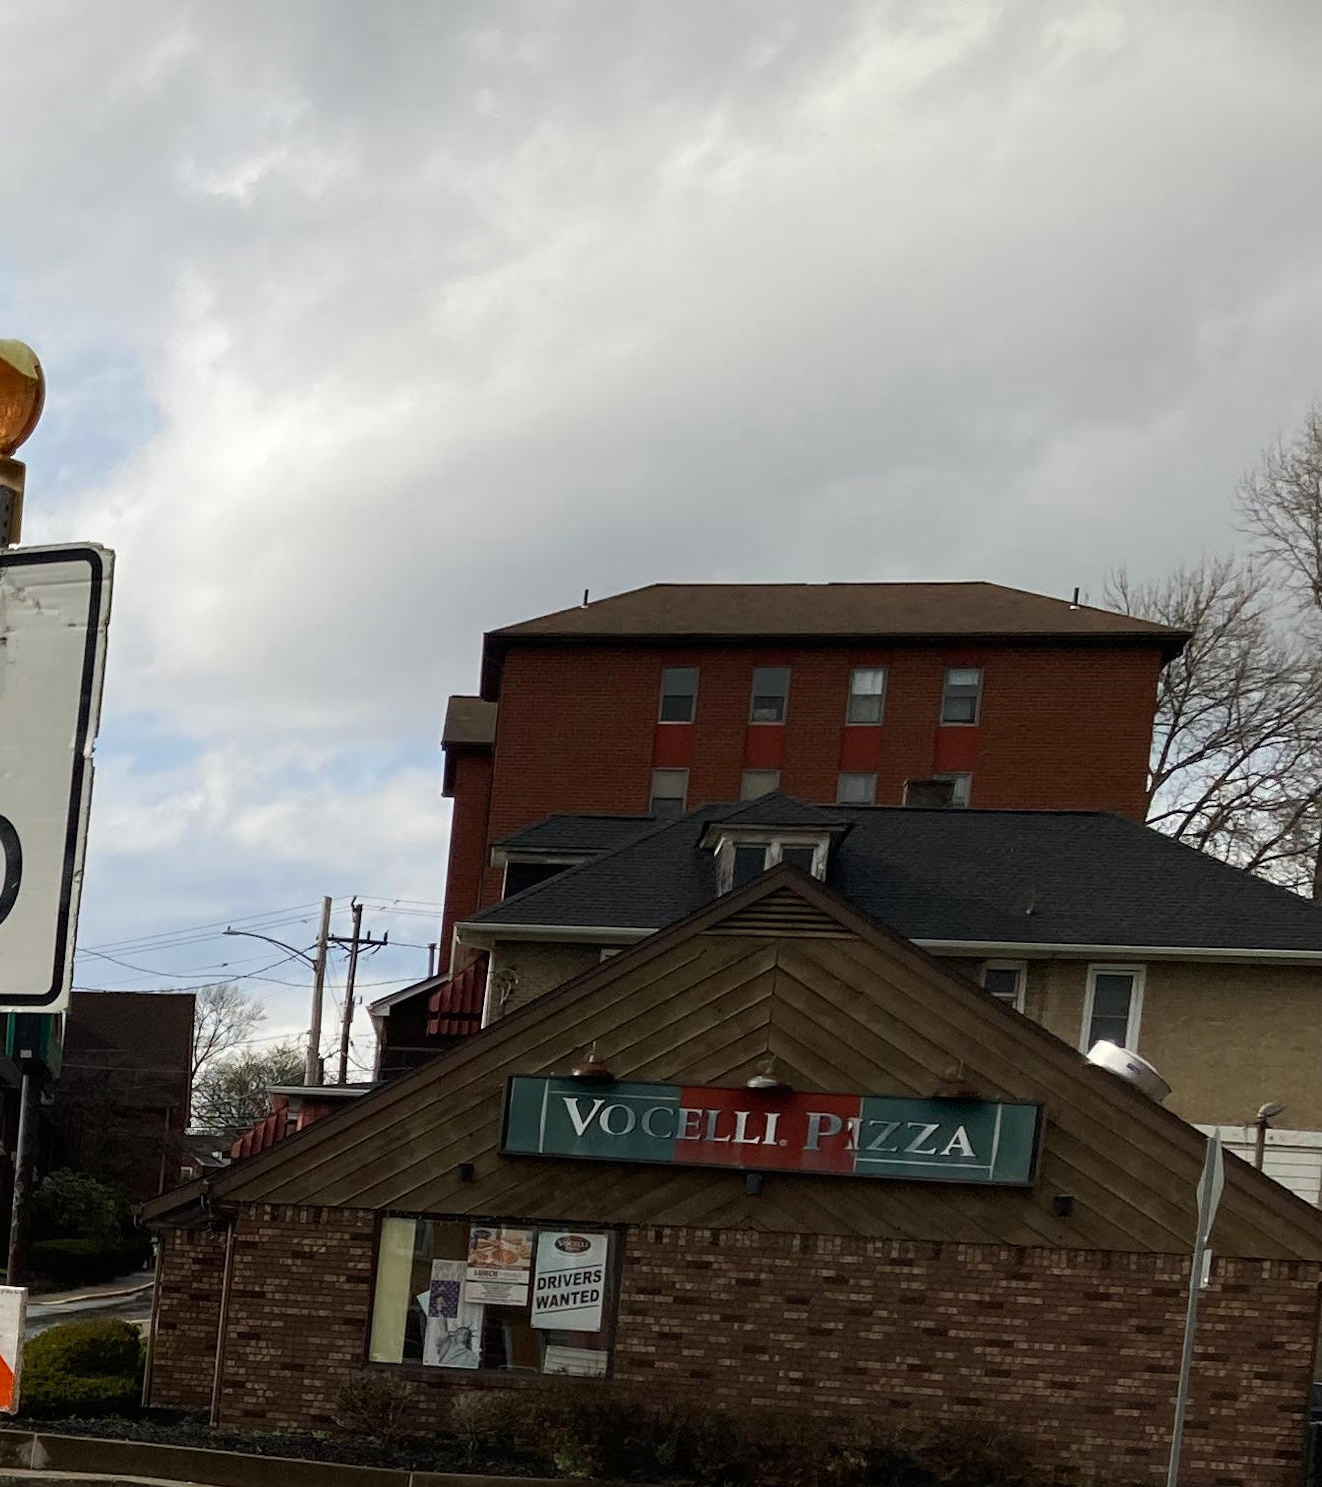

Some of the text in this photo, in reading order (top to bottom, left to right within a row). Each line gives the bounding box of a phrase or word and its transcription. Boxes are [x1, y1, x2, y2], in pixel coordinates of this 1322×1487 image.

[563, 1096, 976, 1158] VOCELLI PIZZA
[537, 1270, 602, 1291] DRIVERS
[536, 1289, 600, 1309] WANTED
